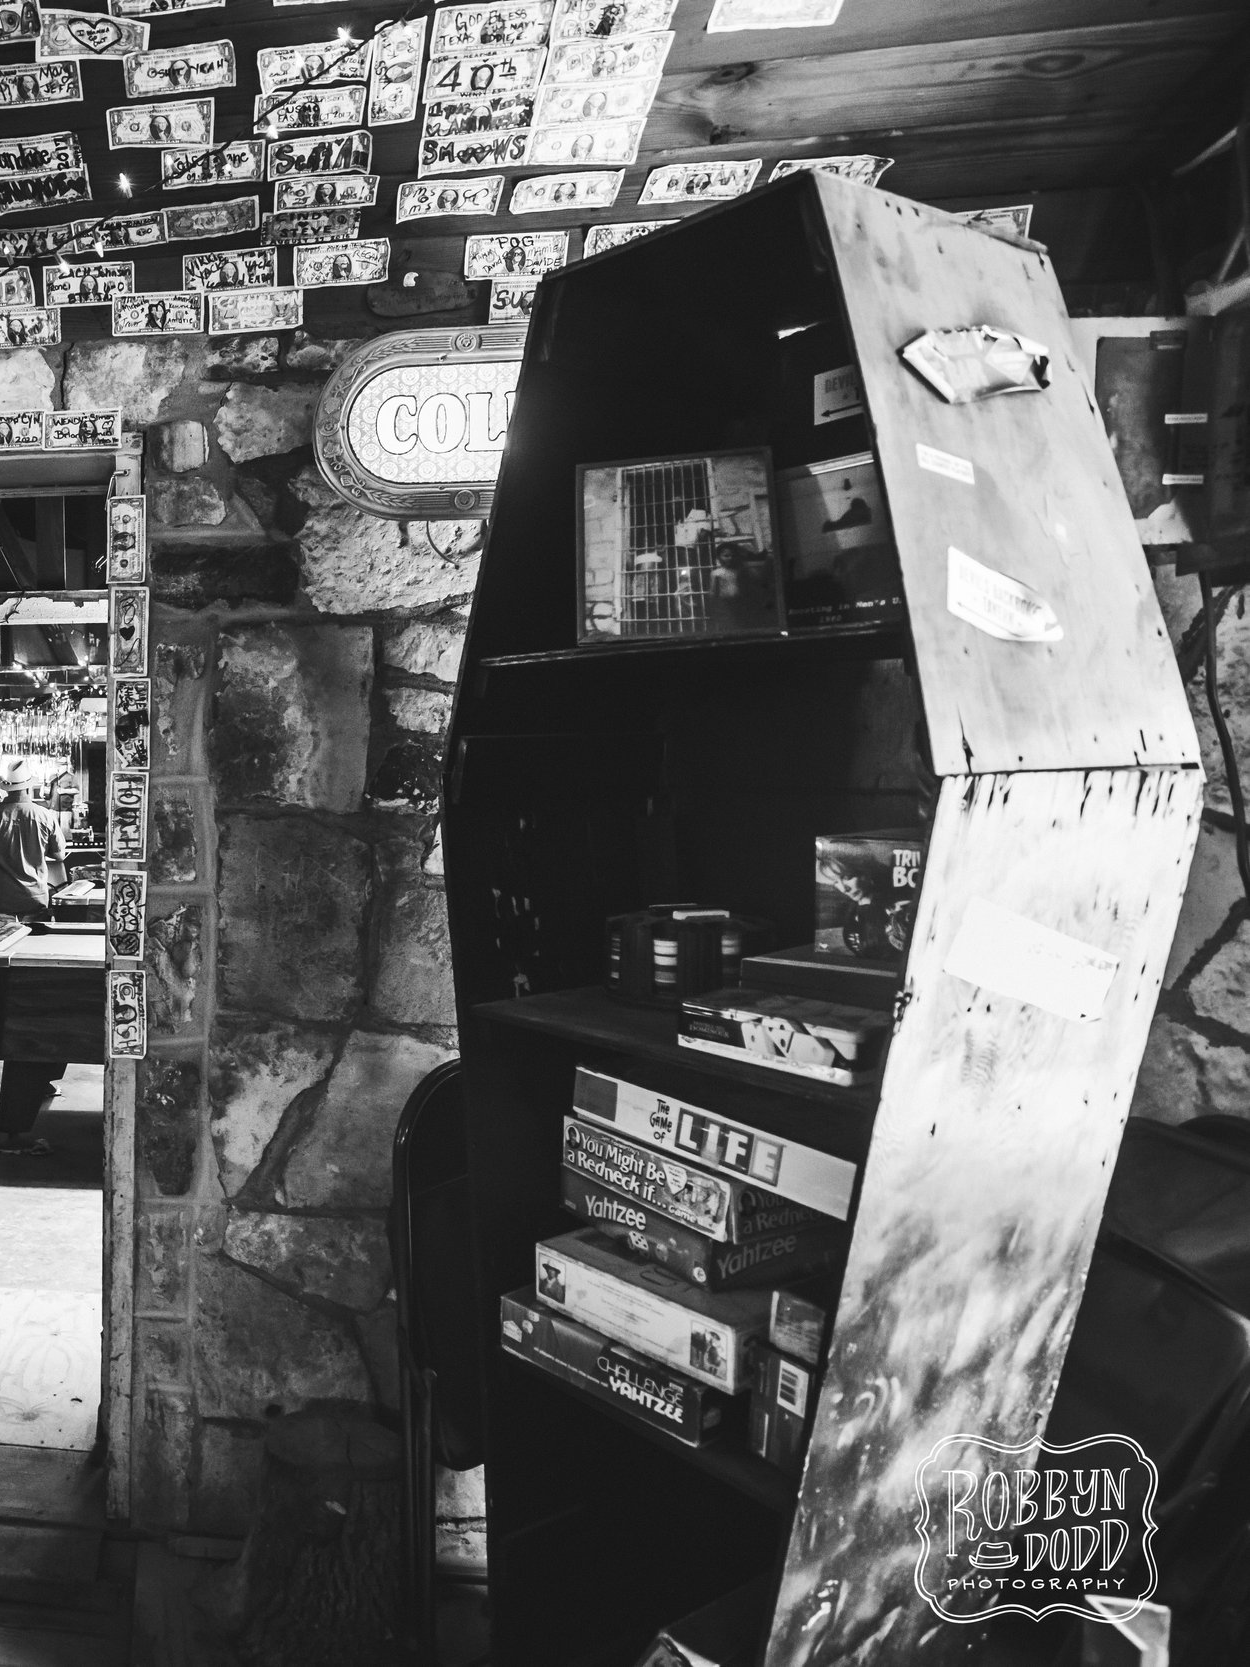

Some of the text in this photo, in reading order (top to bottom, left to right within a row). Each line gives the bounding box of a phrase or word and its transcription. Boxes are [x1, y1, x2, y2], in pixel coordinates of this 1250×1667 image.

[375, 391, 517, 455] COL
[566, 1150, 577, 1164] a
[578, 1153, 640, 1194] Redneck
[580, 1131, 603, 1158] You
[606, 1142, 645, 1175] Might
[647, 1163, 666, 1185] Be
[679, 1112, 779, 1182] LIFE
[585, 1194, 648, 1231] Yahtzee
[717, 1234, 798, 1279] Yahtzee
[597, 1355, 685, 1408] CHALLENGE
[609, 1375, 685, 1424] YAHTZEE
